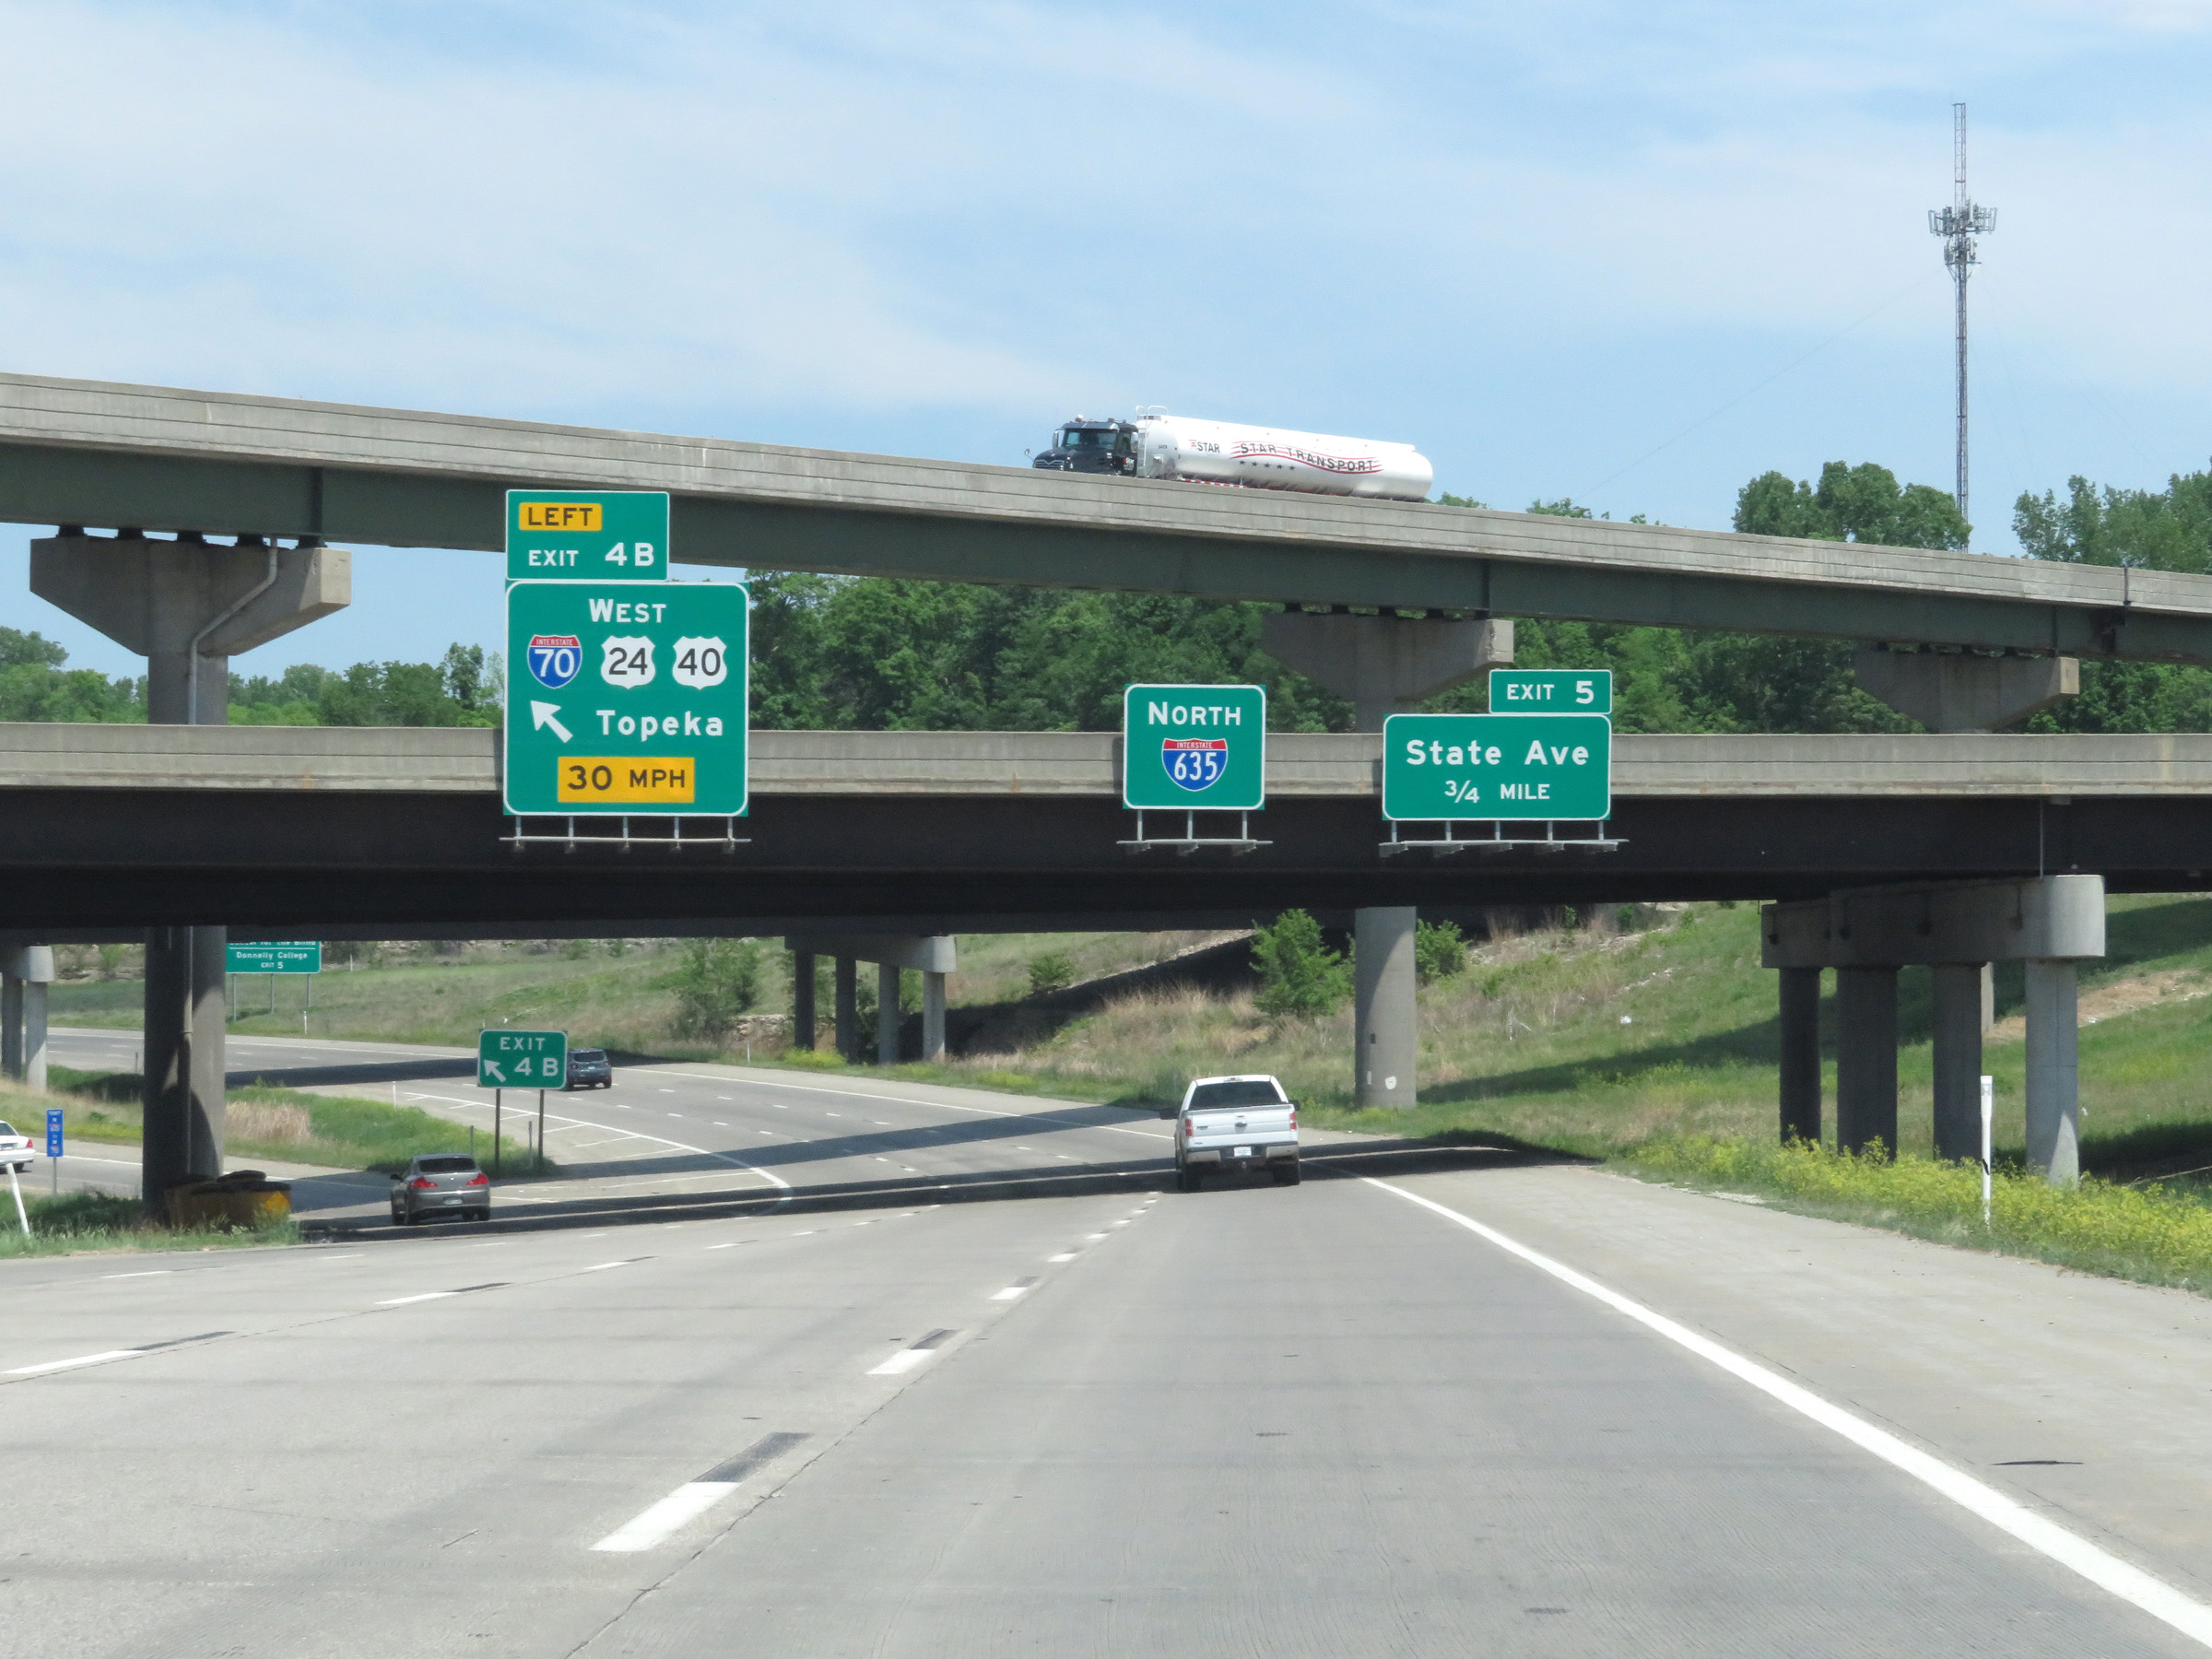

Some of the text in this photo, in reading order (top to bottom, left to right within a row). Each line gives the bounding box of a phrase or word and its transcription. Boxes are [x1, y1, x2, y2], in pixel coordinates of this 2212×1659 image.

[1197, 441, 1220, 453] STAR
[1240, 443, 1373, 471] STAR TRANSPORT
[528, 507, 593, 526] LEFT
[528, 549, 579, 567] EXIT
[589, 598, 666, 623] WEST
[535, 649, 575, 677] 70
[608, 647, 648, 676] 24
[677, 648, 721, 677] 40
[1507, 681, 1594, 704] EXIT 5
[596, 710, 723, 742] Topeka
[1148, 700, 1241, 726] NORTH
[1406, 739, 1590, 766] State Ave
[567, 765, 685, 791] 30 MPH
[1174, 751, 1218, 781] 635
[1500, 783, 1550, 801] MILE
[236, 951, 308, 960] Donnelly College
[500, 1037, 546, 1051] EXIT
